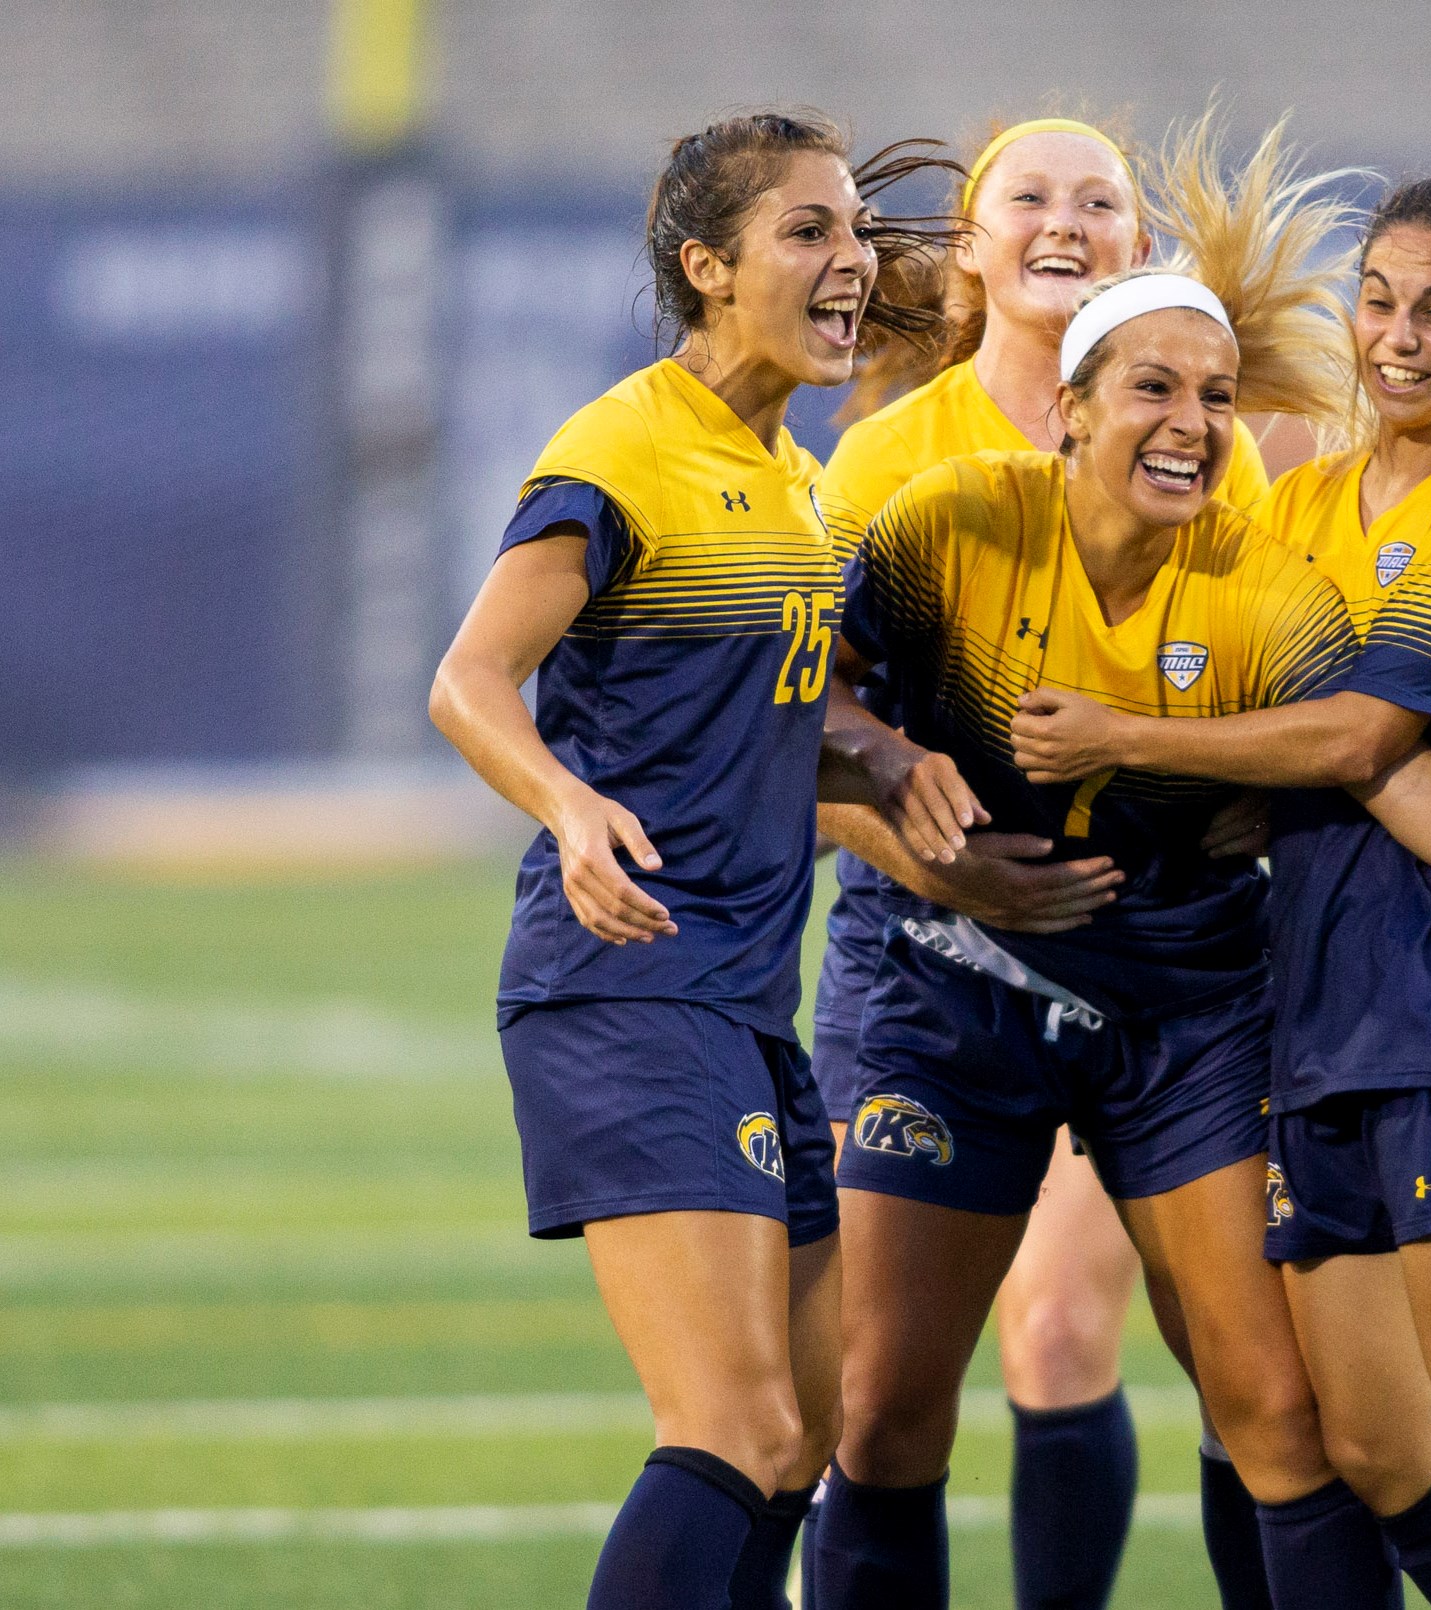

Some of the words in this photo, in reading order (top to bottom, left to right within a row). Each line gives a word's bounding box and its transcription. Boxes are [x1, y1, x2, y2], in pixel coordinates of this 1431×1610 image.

[1376, 556, 1411, 568] MAC
[773, 589, 836, 705] 25
[1160, 656, 1205, 670] MAC
